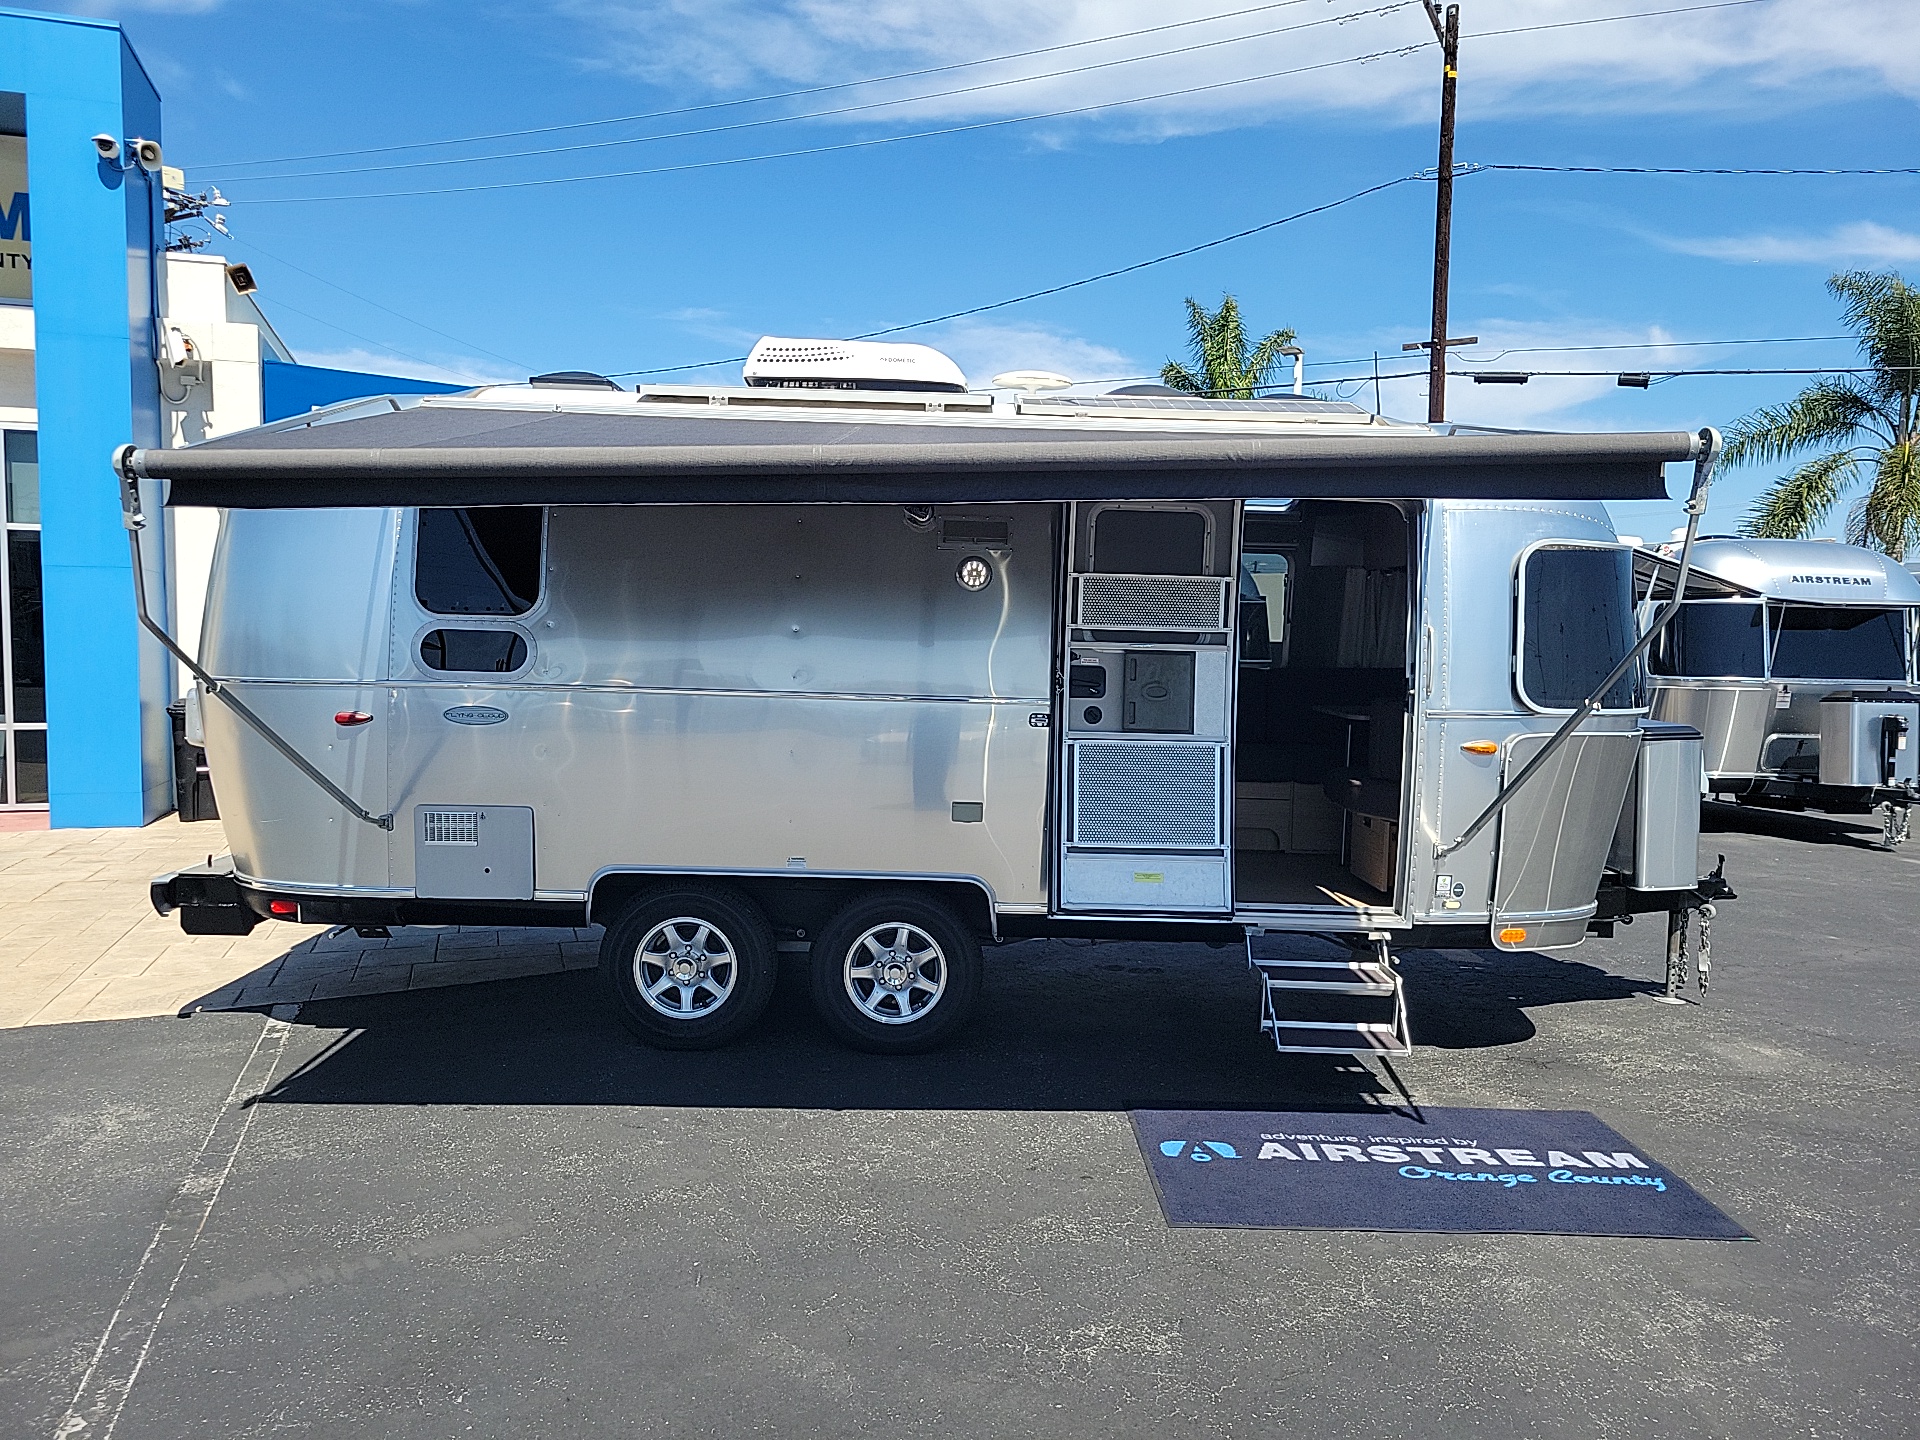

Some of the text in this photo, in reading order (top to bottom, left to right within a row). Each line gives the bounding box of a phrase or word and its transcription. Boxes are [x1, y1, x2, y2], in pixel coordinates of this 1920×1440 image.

[0, 252, 32, 270] TY
[1791, 575, 1872, 586] AIRSTREAM
[1369, 1135, 1449, 1146] inspired
[1451, 1137, 1478, 1148] by
[1257, 1142, 1650, 1169] AIRSTREAM
[1398, 1165, 1667, 1192] Orange County
